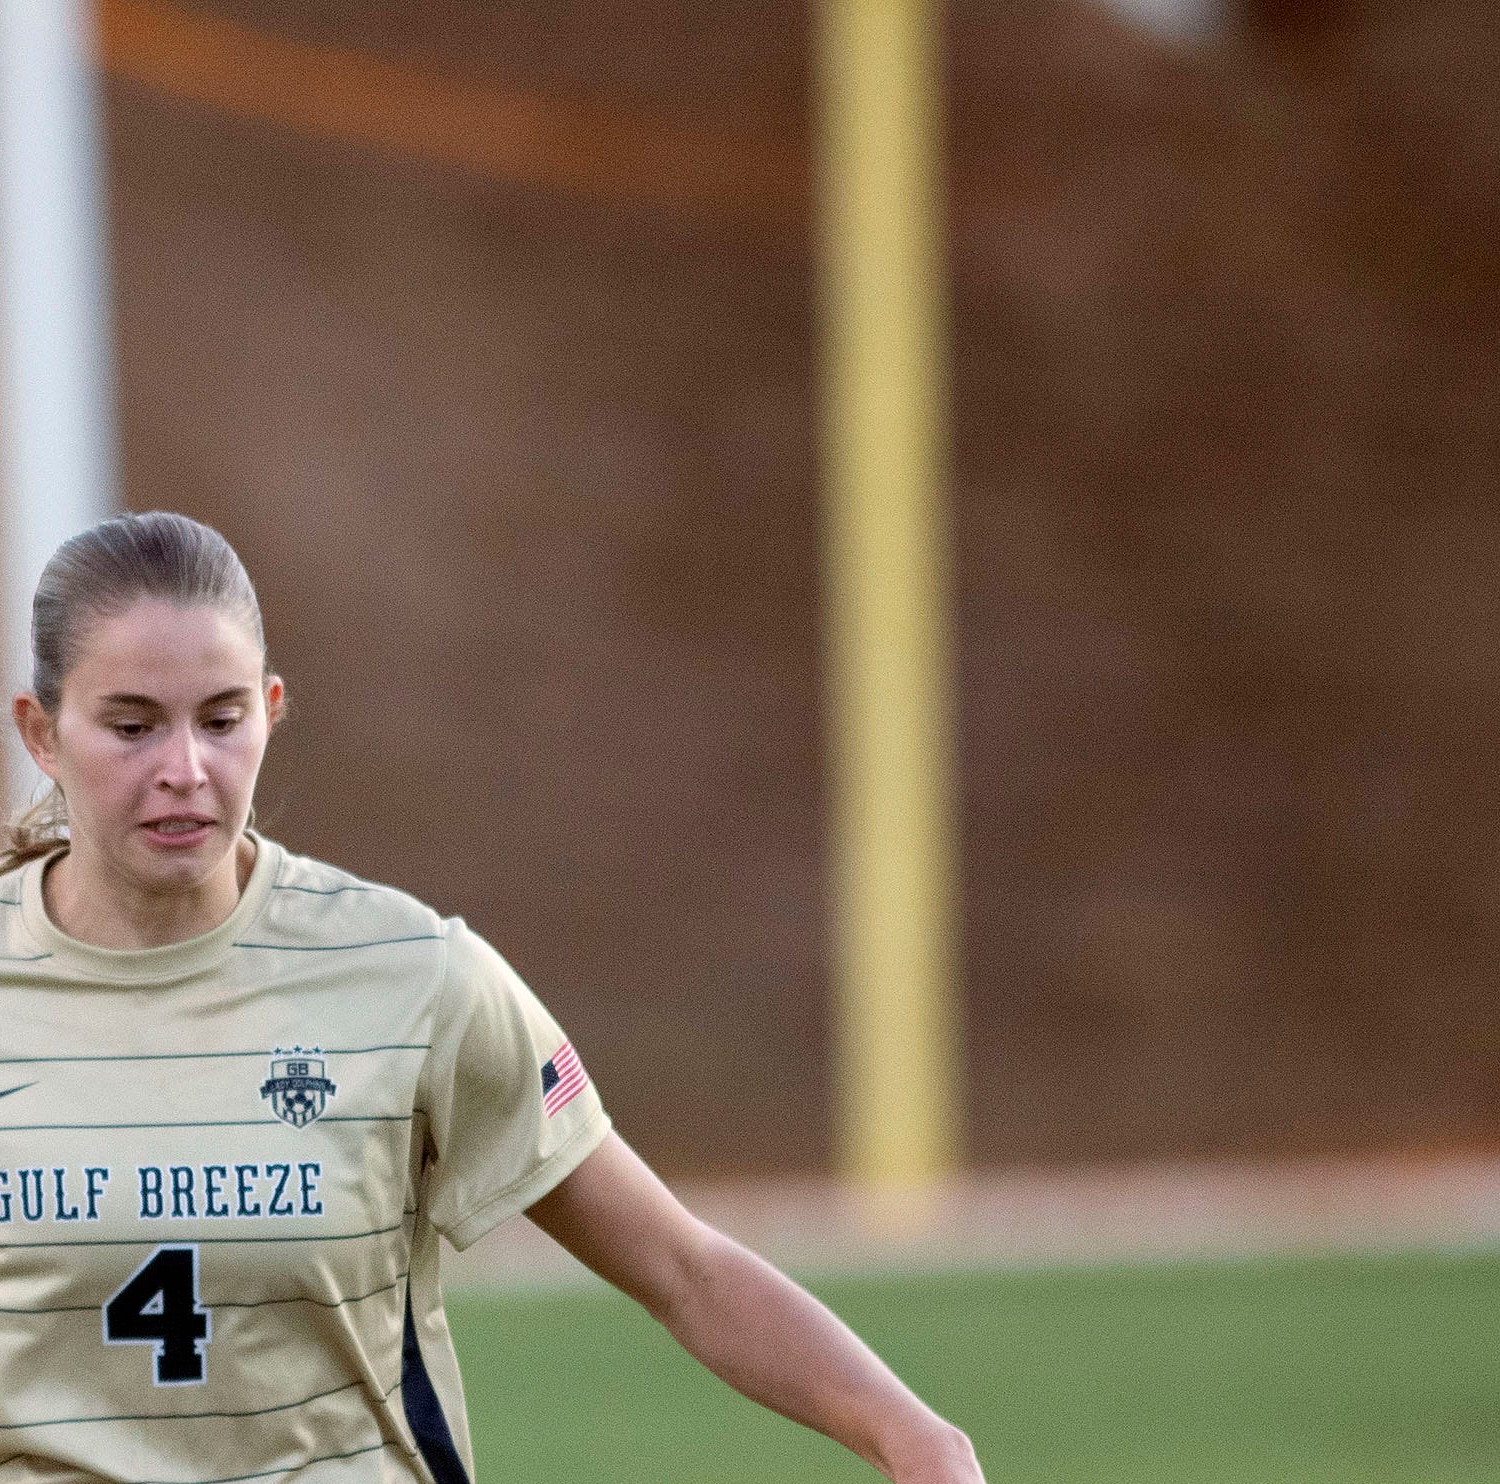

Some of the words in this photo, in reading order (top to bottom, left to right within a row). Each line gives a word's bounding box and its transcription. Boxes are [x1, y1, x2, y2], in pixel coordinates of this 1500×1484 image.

[286, 1062, 309, 1076] GB
[139, 1162, 324, 1218] BREEZE
[105, 1246, 210, 1384] 4
